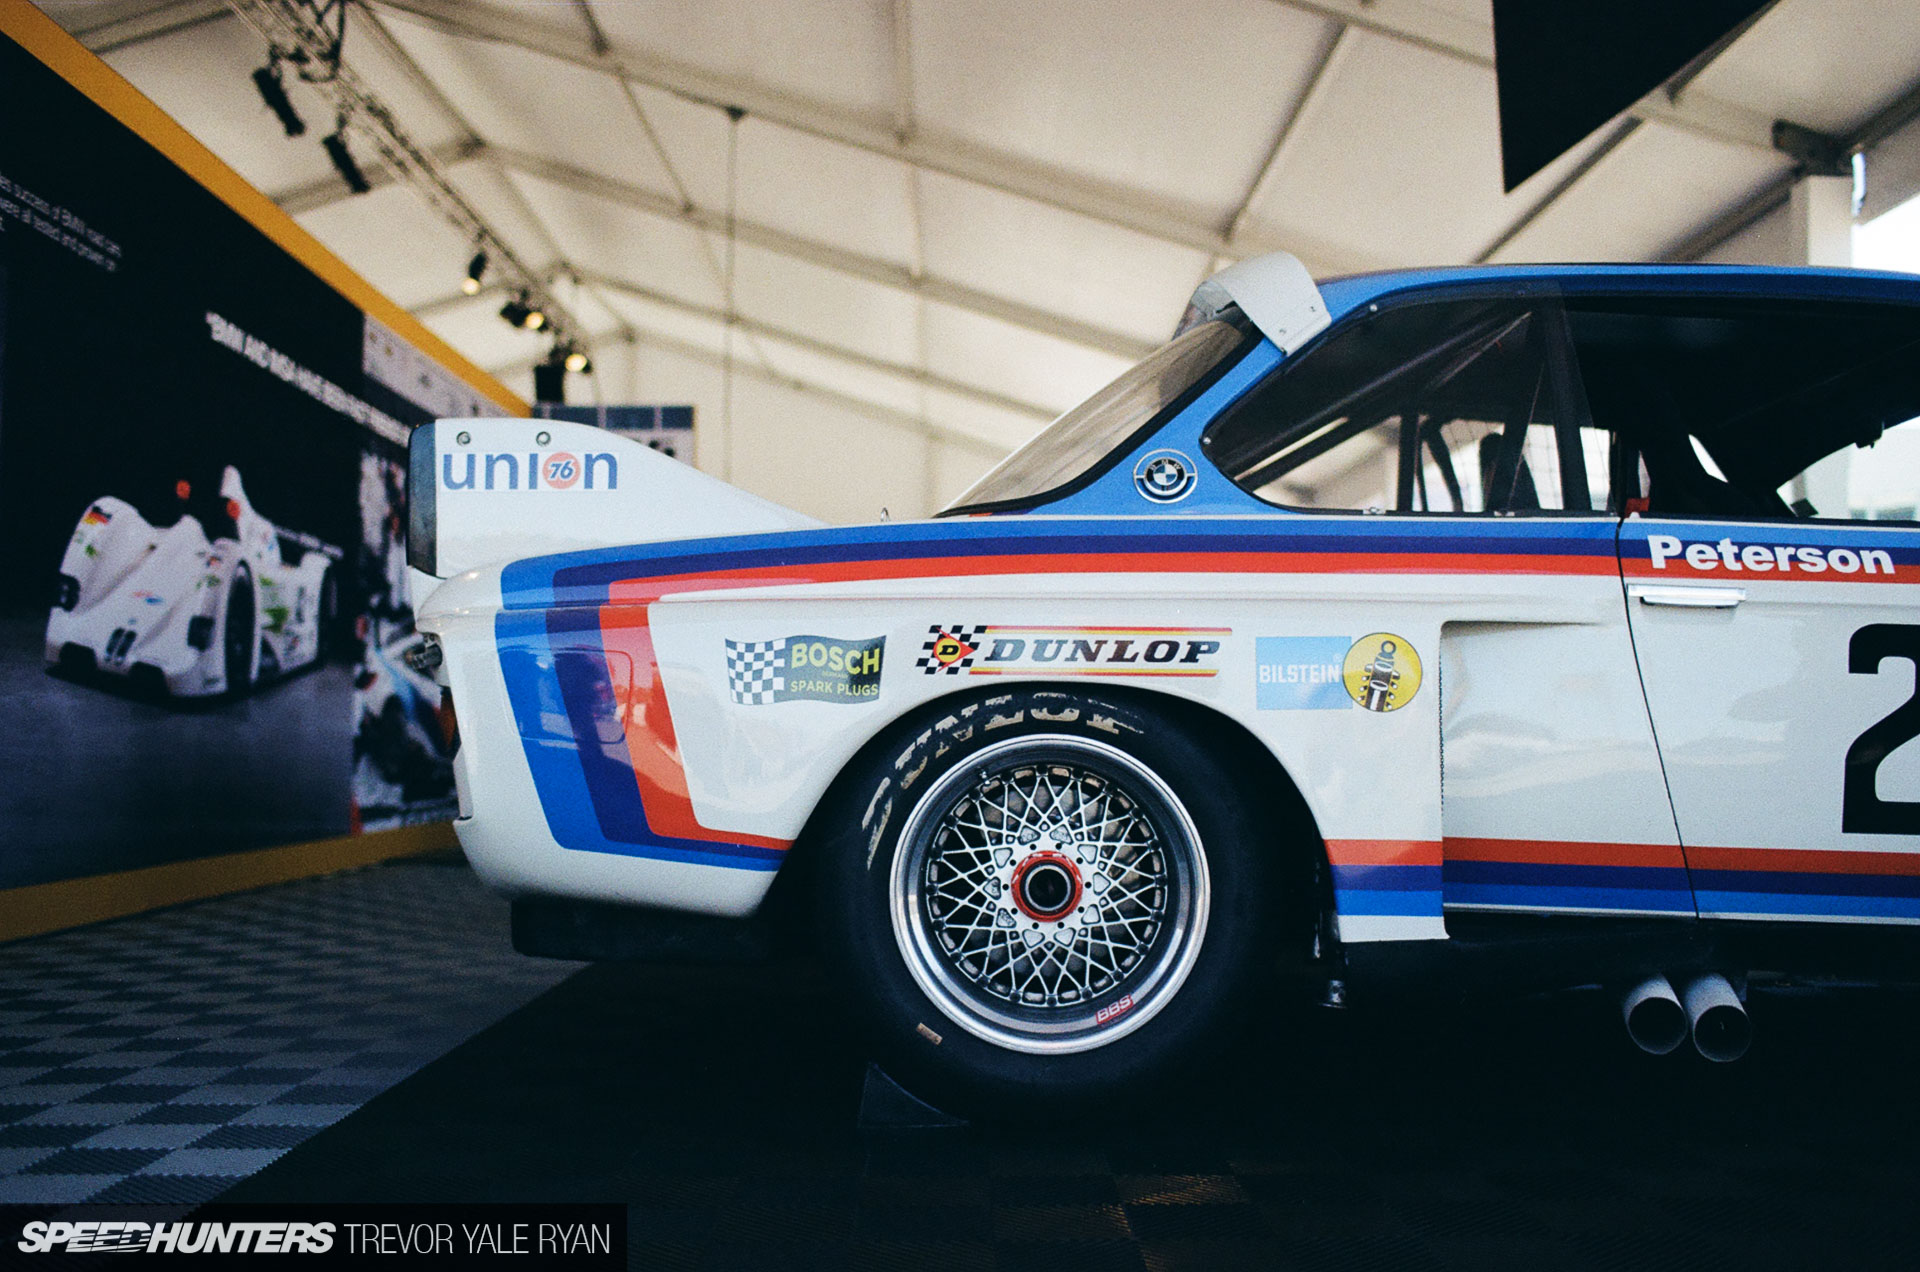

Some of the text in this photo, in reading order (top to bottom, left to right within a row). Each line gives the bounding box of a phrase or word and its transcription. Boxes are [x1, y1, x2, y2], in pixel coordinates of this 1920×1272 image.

[549, 460, 574, 481] 76
[1647, 534, 1896, 575] Peterson
[791, 642, 880, 675] BOSCH
[984, 638, 1220, 663] DUNLOP
[1259, 664, 1341, 684] BILSTEIN
[790, 679, 879, 697] SPARK PLUGS
[1842, 622, 1920, 836] 2
[1096, 995, 1132, 1022] BBS
